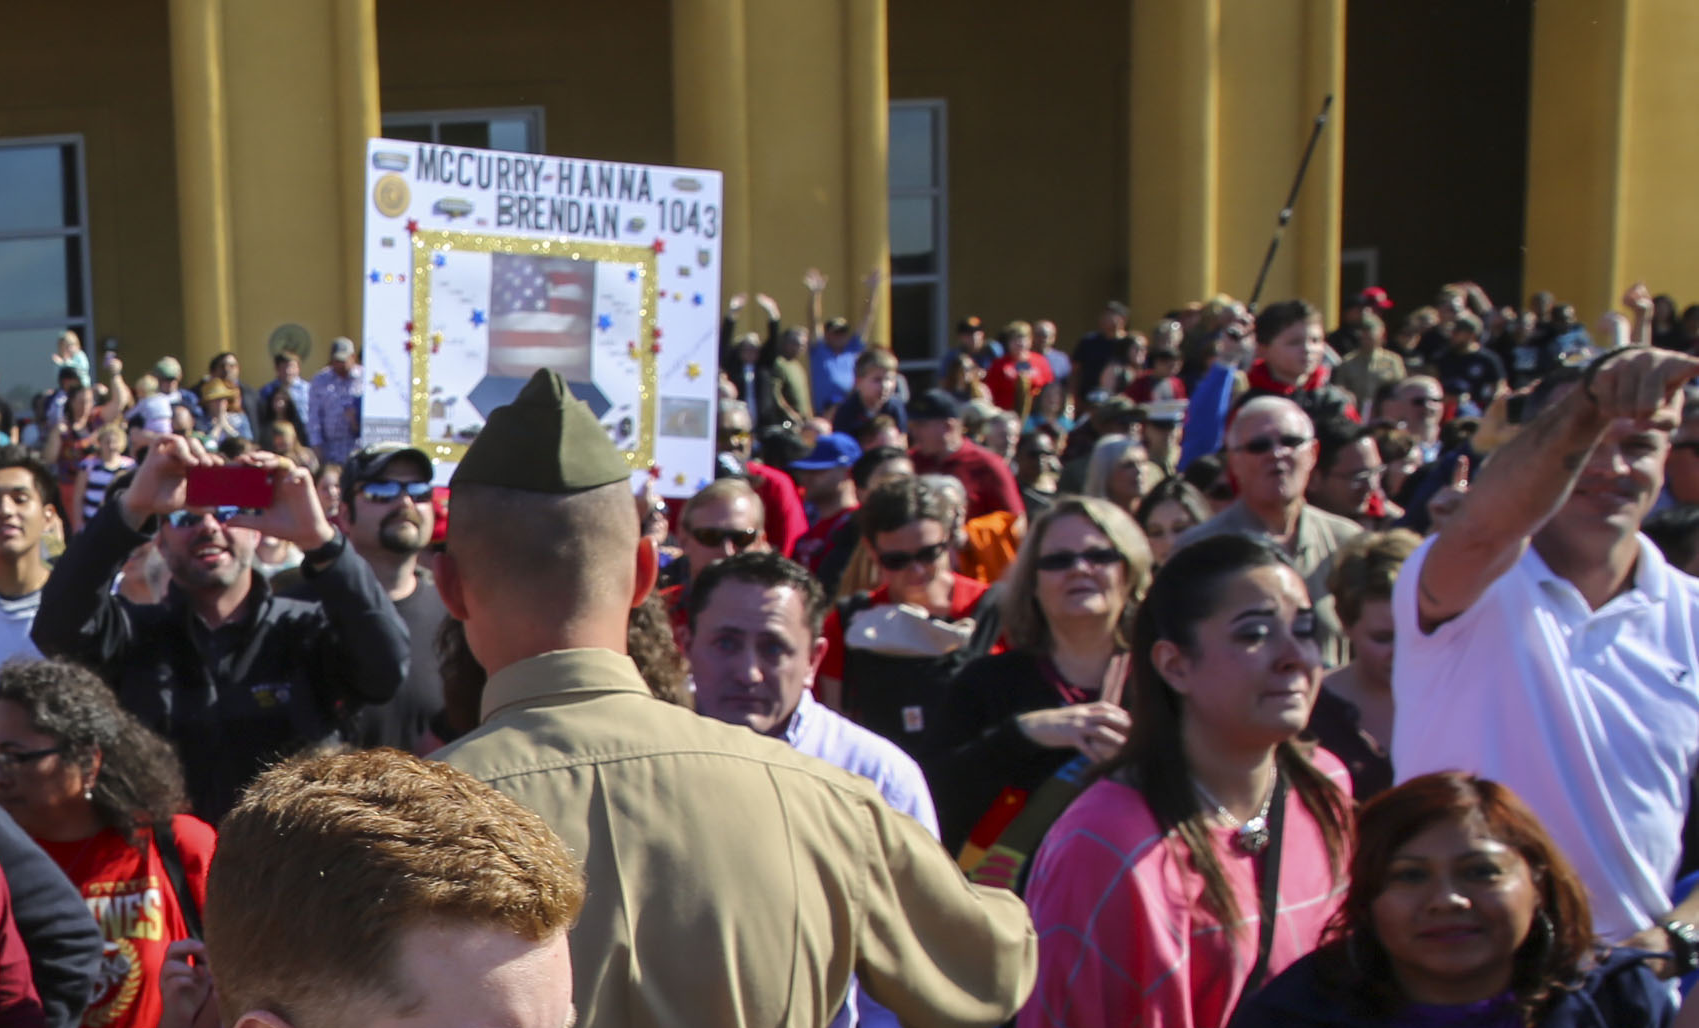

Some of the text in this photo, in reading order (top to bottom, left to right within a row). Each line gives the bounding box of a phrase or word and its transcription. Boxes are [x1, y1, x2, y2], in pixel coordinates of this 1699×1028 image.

[416, 144, 653, 202] MCCURRY-HANNA
[496, 195, 718, 239] BRENDAN 1043
